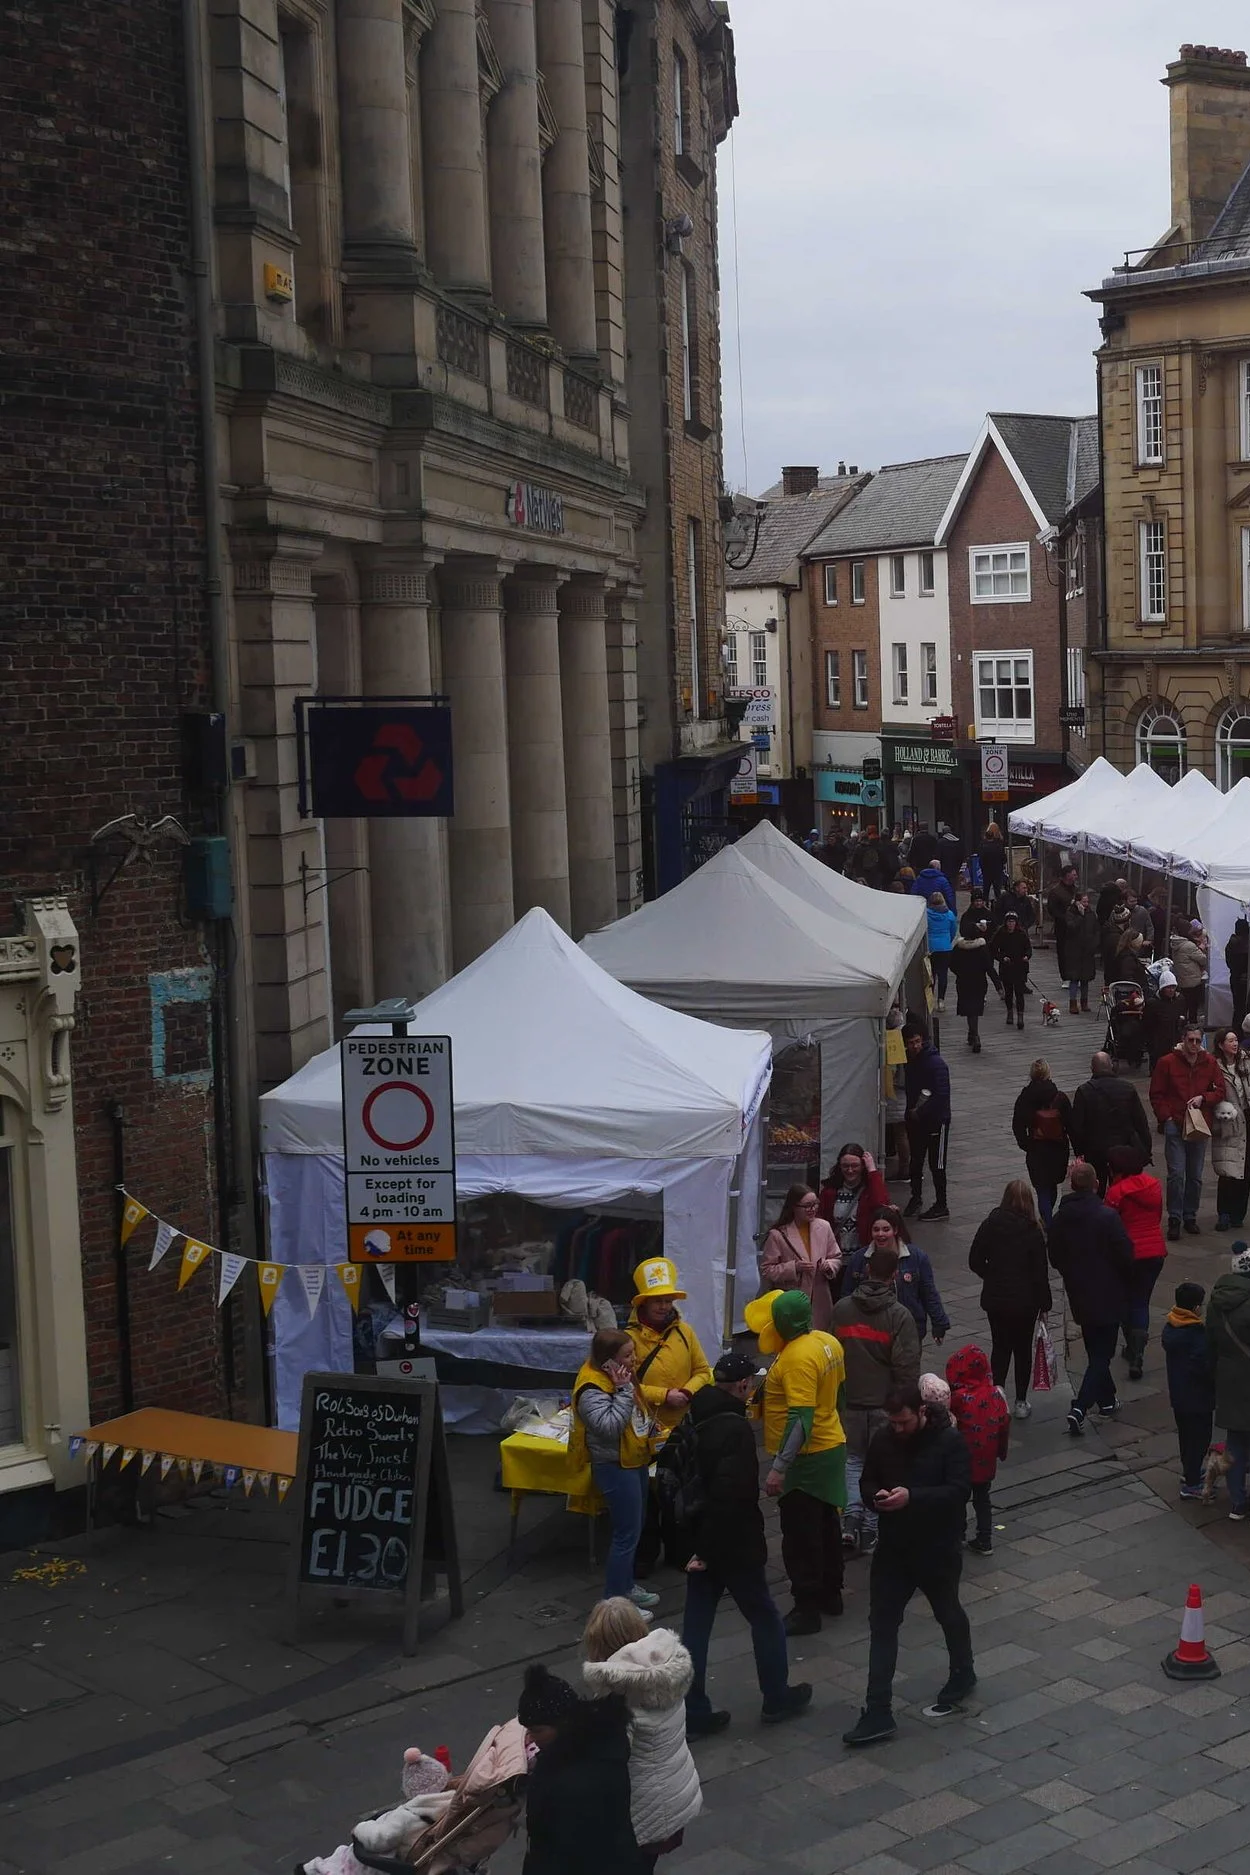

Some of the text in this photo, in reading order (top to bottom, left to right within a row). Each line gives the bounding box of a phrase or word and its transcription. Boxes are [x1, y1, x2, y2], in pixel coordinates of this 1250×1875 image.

[730, 689, 771, 698] TESCO
[746, 702, 772, 712] ress
[894, 746, 958, 766] HOLLAND & BARRE
[1008, 766, 1035, 781] RTILLA
[349, 1042, 444, 1054] PEDESTRIAN
[362, 1057, 431, 1075] ZONE
[360, 1154, 440, 1166] No vehicles
[365, 1178, 436, 1191] Except for
[376, 1192, 426, 1205] loading
[360, 1206, 369, 1217] 4
[373, 1208, 393, 1219] pm
[404, 1206, 420, 1217] 10
[423, 1207, 443, 1217] am
[397, 1230, 441, 1243] At any
[404, 1243, 434, 1255] time
[371, 1404, 384, 1422] of
[385, 1404, 420, 1425] Durham
[323, 1417, 415, 1442] Retro Sweets
[314, 1441, 339, 1461] The
[341, 1444, 363, 1467] Very
[314, 1463, 377, 1479] Handmade
[309, 1481, 413, 1524] FUDGE
